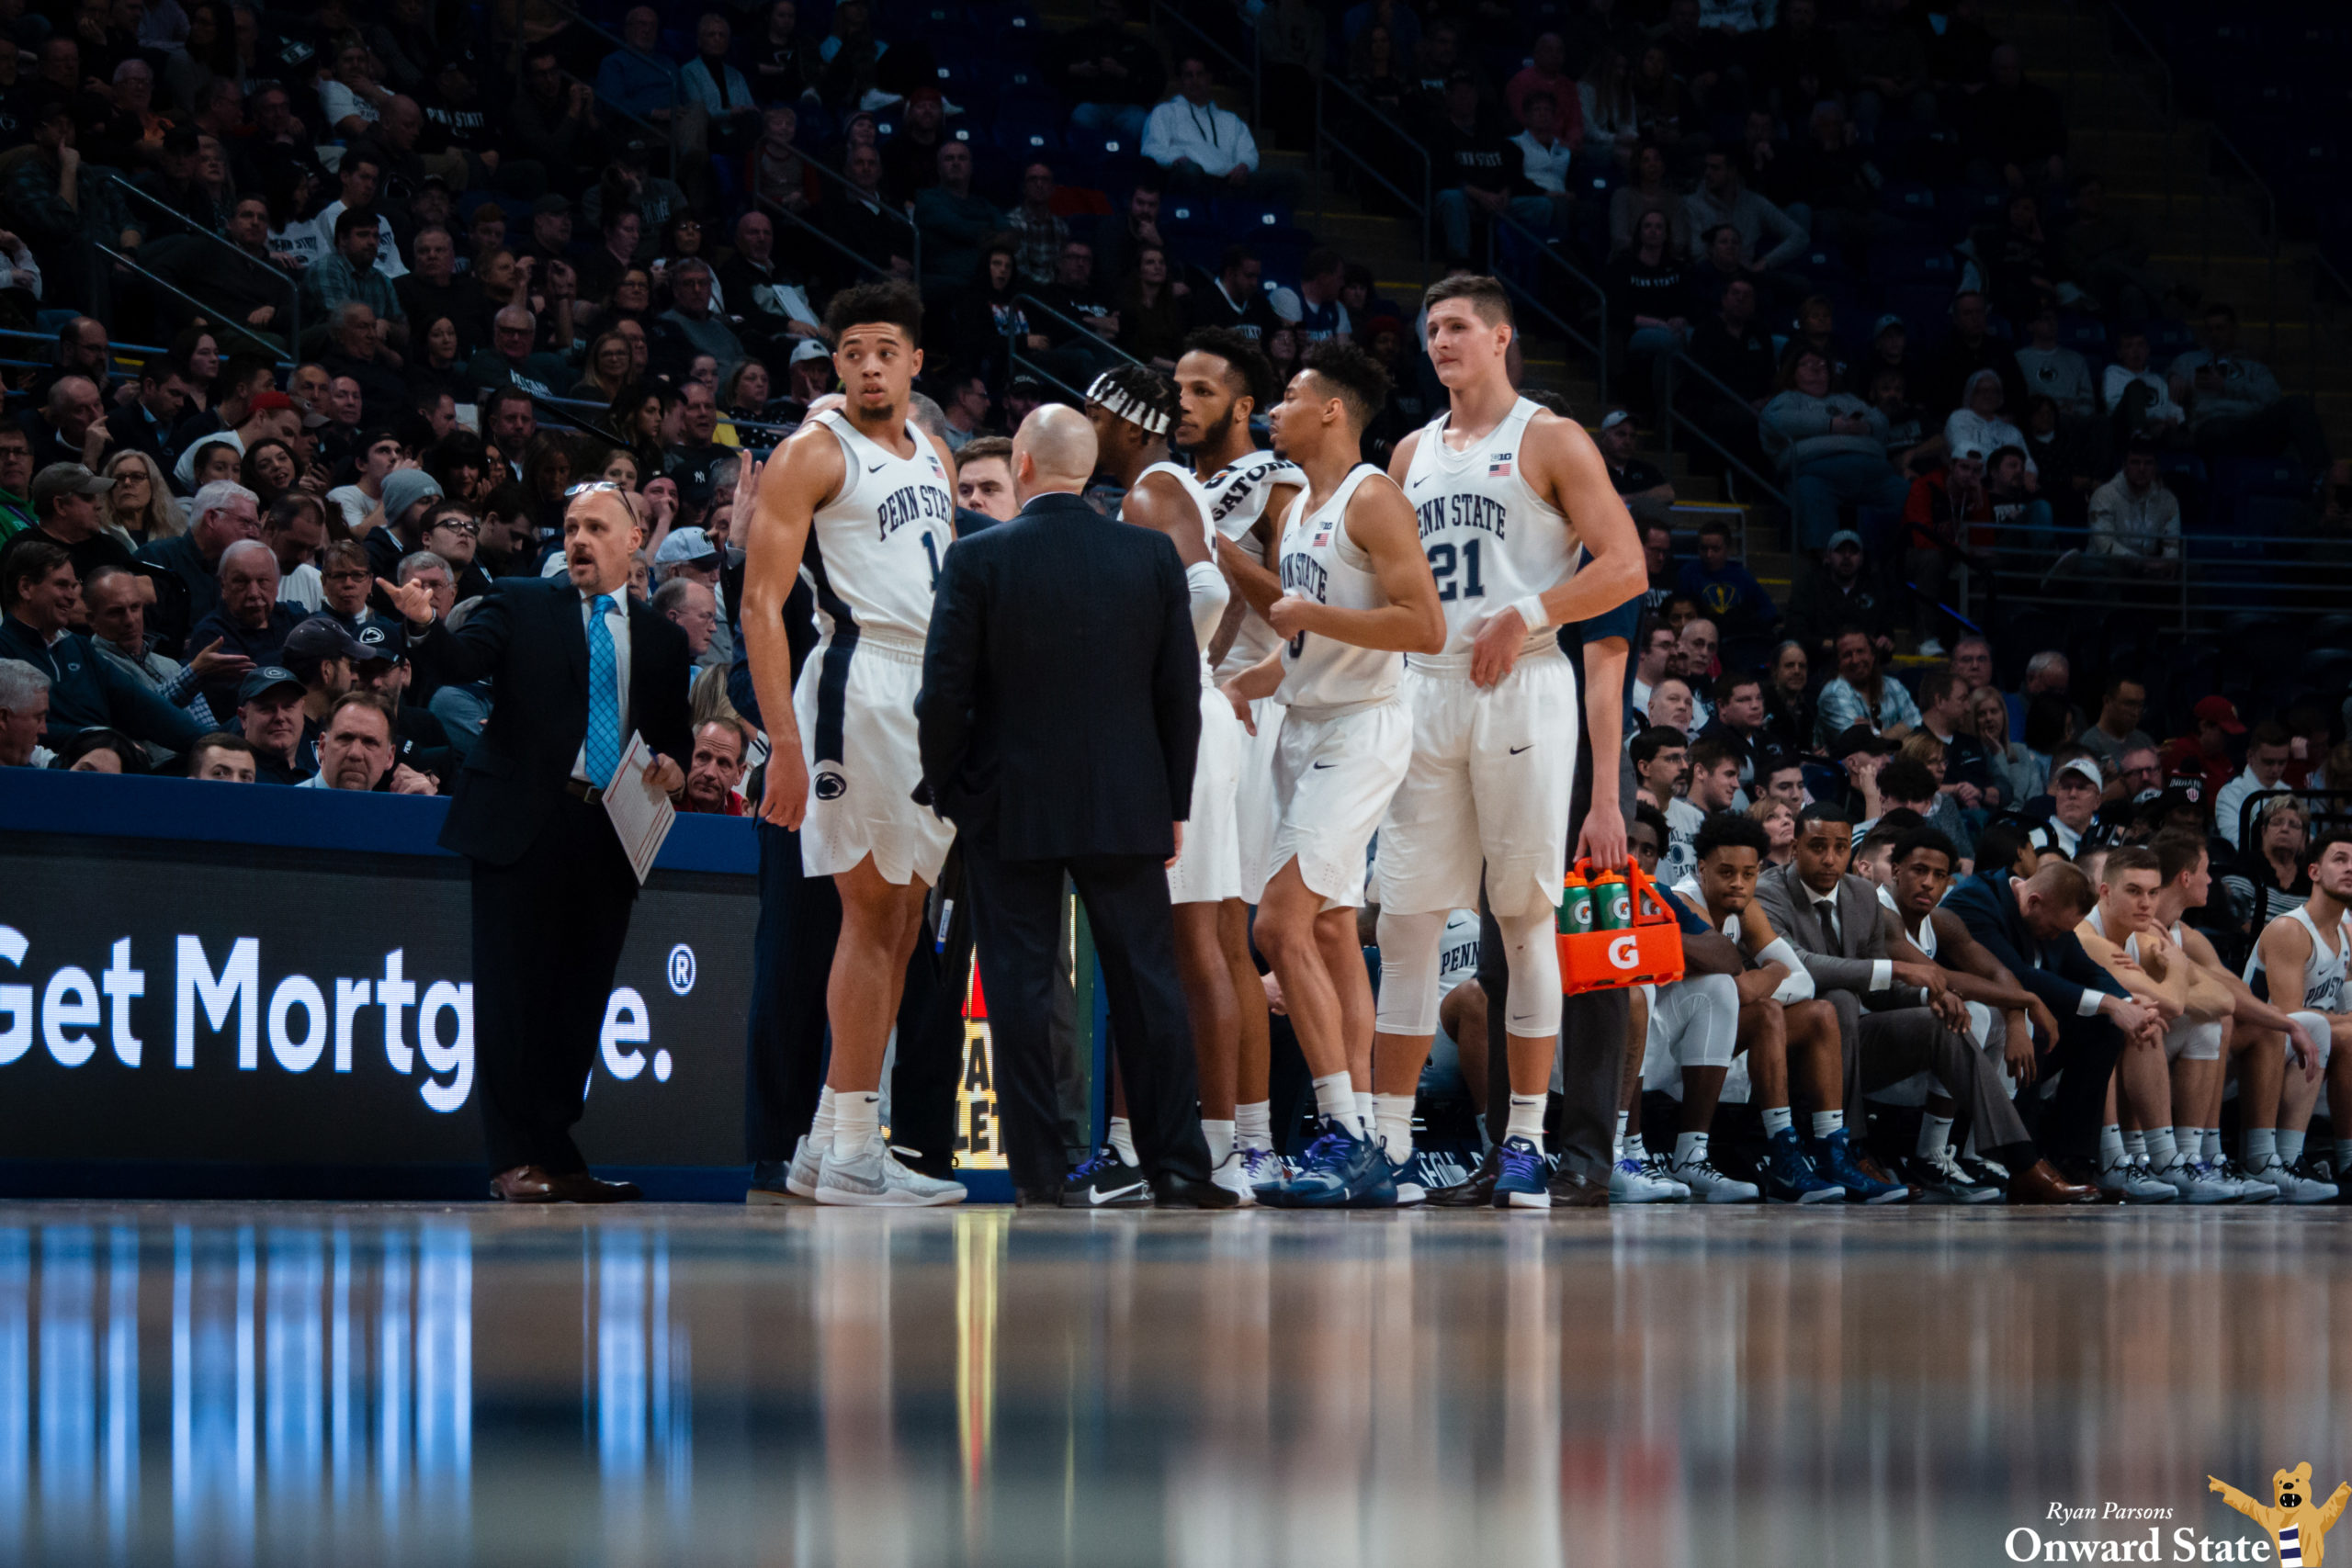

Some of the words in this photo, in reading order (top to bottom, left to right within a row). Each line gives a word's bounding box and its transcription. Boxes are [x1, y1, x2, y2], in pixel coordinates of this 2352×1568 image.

[877, 486, 920, 542] PENN
[1415, 496, 1445, 540] ENN
[1452, 493, 1506, 541] STATE
[1296, 552, 1328, 604] STATE
[1427, 537, 1486, 602] 21
[1575, 900, 1592, 924] G
[1613, 897, 1631, 920] G
[1440, 941, 1480, 976] PENN
[1608, 935, 1639, 970] G
[0, 925, 145, 1067] Get
